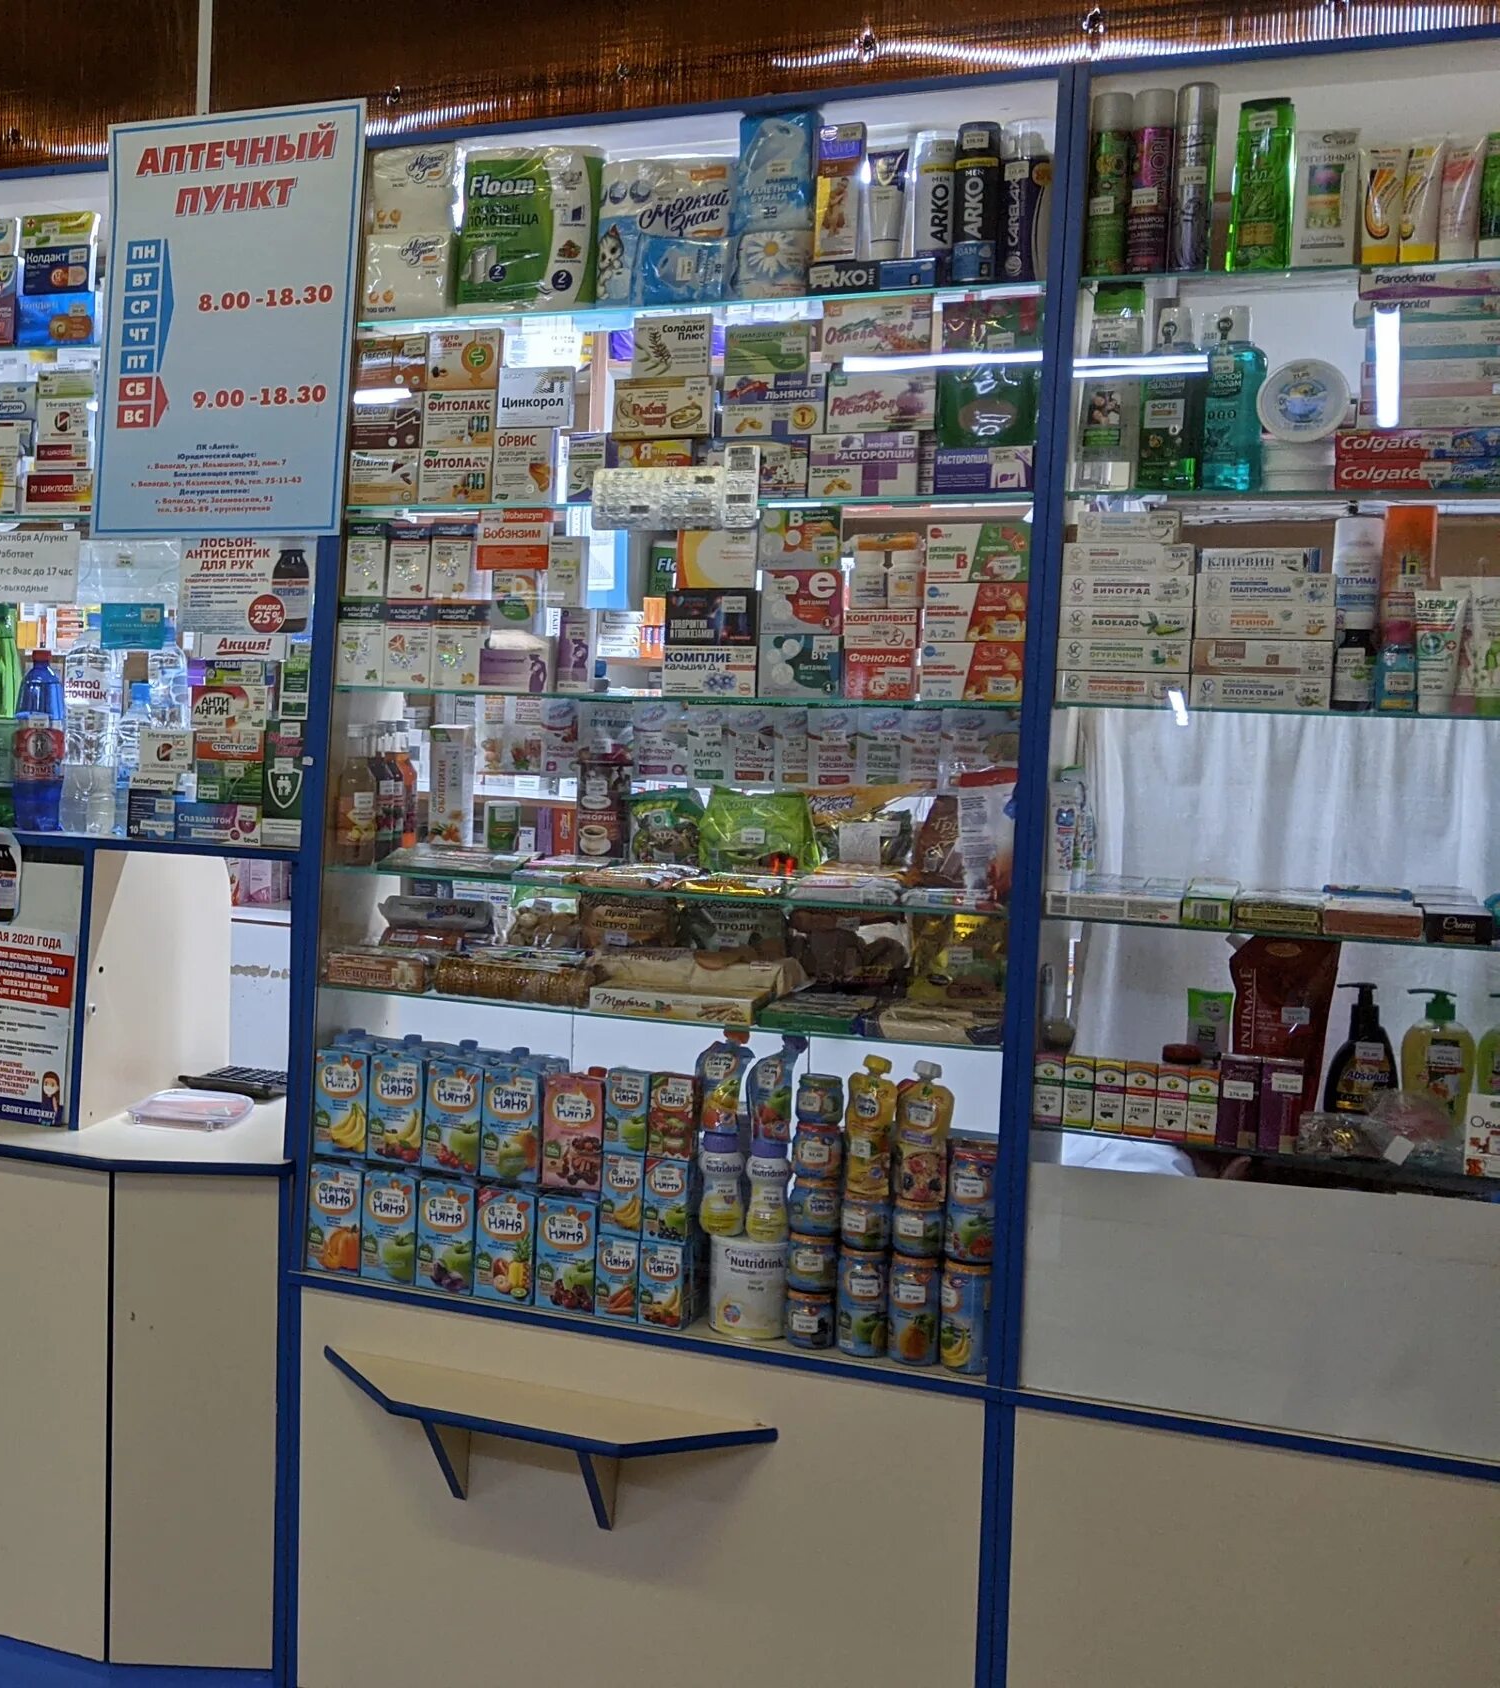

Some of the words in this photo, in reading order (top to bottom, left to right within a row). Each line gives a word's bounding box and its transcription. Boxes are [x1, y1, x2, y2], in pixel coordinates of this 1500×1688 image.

[136, 124, 338, 176] АПТЕЧНЫЙ
[965, 168, 984, 177] MEN
[470, 174, 534, 197] Floom
[175, 177, 297, 216] ПУНКТ
[638, 189, 729, 228] Мягкий
[964, 176, 984, 238] ARKO
[931, 184, 949, 244] ARKO
[673, 209, 720, 232] Знак
[26, 253, 66, 264] Колдакт
[131, 245, 156, 260] ПН
[493, 266, 501, 277] 2
[131, 273, 152, 287] ВТ
[558, 272, 566, 284] 2
[1376, 272, 1436, 284] Parodontol
[130, 299, 151, 314] СР
[662, 324, 705, 333] Солодки
[128, 328, 149, 342] ЧТ
[678, 332, 704, 341] Плюс
[126, 355, 148, 370] ПТ
[125, 382, 146, 397] СБ
[765, 388, 816, 400] ЛЬНЯНОЕ
[428, 400, 490, 412] ФИТОЛАКС
[502, 398, 564, 410] Цинкорол
[632, 402, 667, 416] Рыбий
[123, 409, 145, 423] ВС
[800, 412, 806, 422] 1
[498, 432, 537, 446] ОРВИС
[1341, 436, 1420, 452] Colgate
[835, 450, 914, 460] РАСТОРОПШИ
[938, 454, 988, 464] РАСТОРОПША
[1341, 465, 1420, 482] Colgate
[40, 486, 88, 494] ЦИКЛОФЕРОН
[502, 511, 544, 520] Wobenzym
[33, 532, 68, 544] А/пункт
[483, 528, 540, 539] Вобэнзим
[200, 538, 257, 548] ЛОСЬОН-
[186, 548, 270, 558] АНТИСЕПТИК
[200, 560, 226, 570] ДЛЯ
[230, 560, 254, 569] РУК
[1208, 557, 1274, 567] КЛИРВИН
[33, 568, 44, 577] до
[48, 567, 56, 576] 17
[1230, 586, 1290, 594] ГИАЛУРОНОВЫЙ
[250, 612, 282, 624] -25%
[846, 614, 915, 623] КОМПЛИВИТ
[217, 638, 272, 652] Акция!
[850, 654, 907, 664] Фенюльс
[1088, 684, 1144, 692] ПЕРСИКОВЫЙ
[1222, 688, 1284, 697] ХЛОПКОВЫЙ
[202, 696, 229, 706] АНТИ
[195, 706, 229, 716] АНГИН
[694, 750, 721, 758] Мисо
[818, 754, 836, 762] Каша
[694, 758, 710, 767] суп
[178, 814, 232, 824] Спазмалгон
[130, 824, 138, 834] 10
[12, 933, 34, 946] 2020
[38, 936, 62, 950] ГОДА
[40, 965, 66, 976] ЗАЩИТЫ
[596, 992, 651, 1009] Трубочки
[1241, 968, 1253, 1048] INTIMATE
[380, 1084, 413, 1096] НЯНЯ
[494, 1097, 528, 1112] НЯНЯ
[2, 1104, 22, 1114] СВОИХ
[24, 1108, 56, 1119] БЛИЗКИХ!
[706, 1163, 742, 1174] Nutridrink
[752, 1167, 790, 1178] Nutridrink
[318, 1193, 350, 1206] НЯНЯ
[374, 1202, 405, 1214] НЯНЯ
[488, 1218, 522, 1232] НЯНЯ
[730, 1257, 784, 1270] Nutridrink
